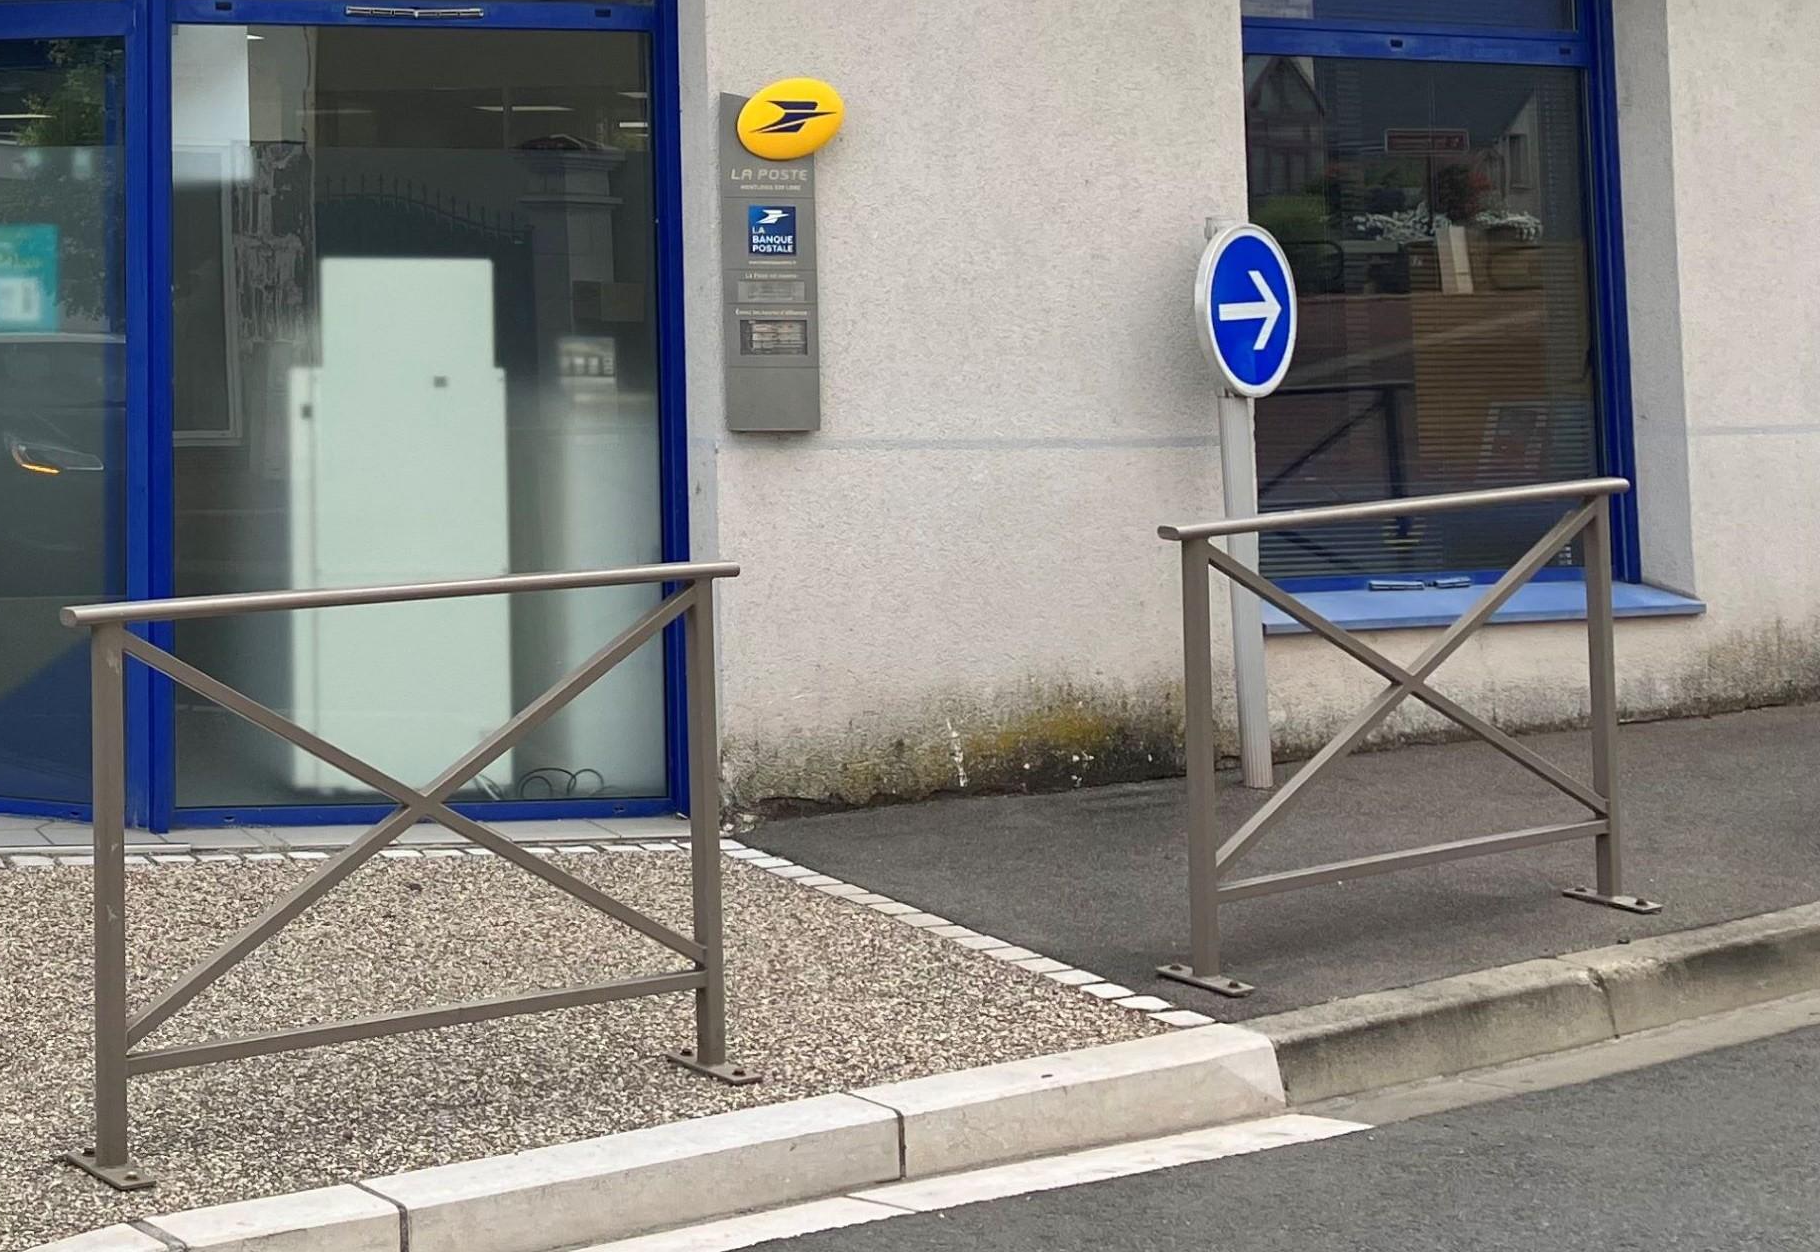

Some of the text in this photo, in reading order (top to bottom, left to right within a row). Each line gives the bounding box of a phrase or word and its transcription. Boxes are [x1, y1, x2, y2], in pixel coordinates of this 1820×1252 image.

[730, 168, 809, 181] LA POSTE
[752, 226, 766, 235] LA
[752, 235, 794, 244] BANQUE
[752, 244, 794, 253] POSTALE
